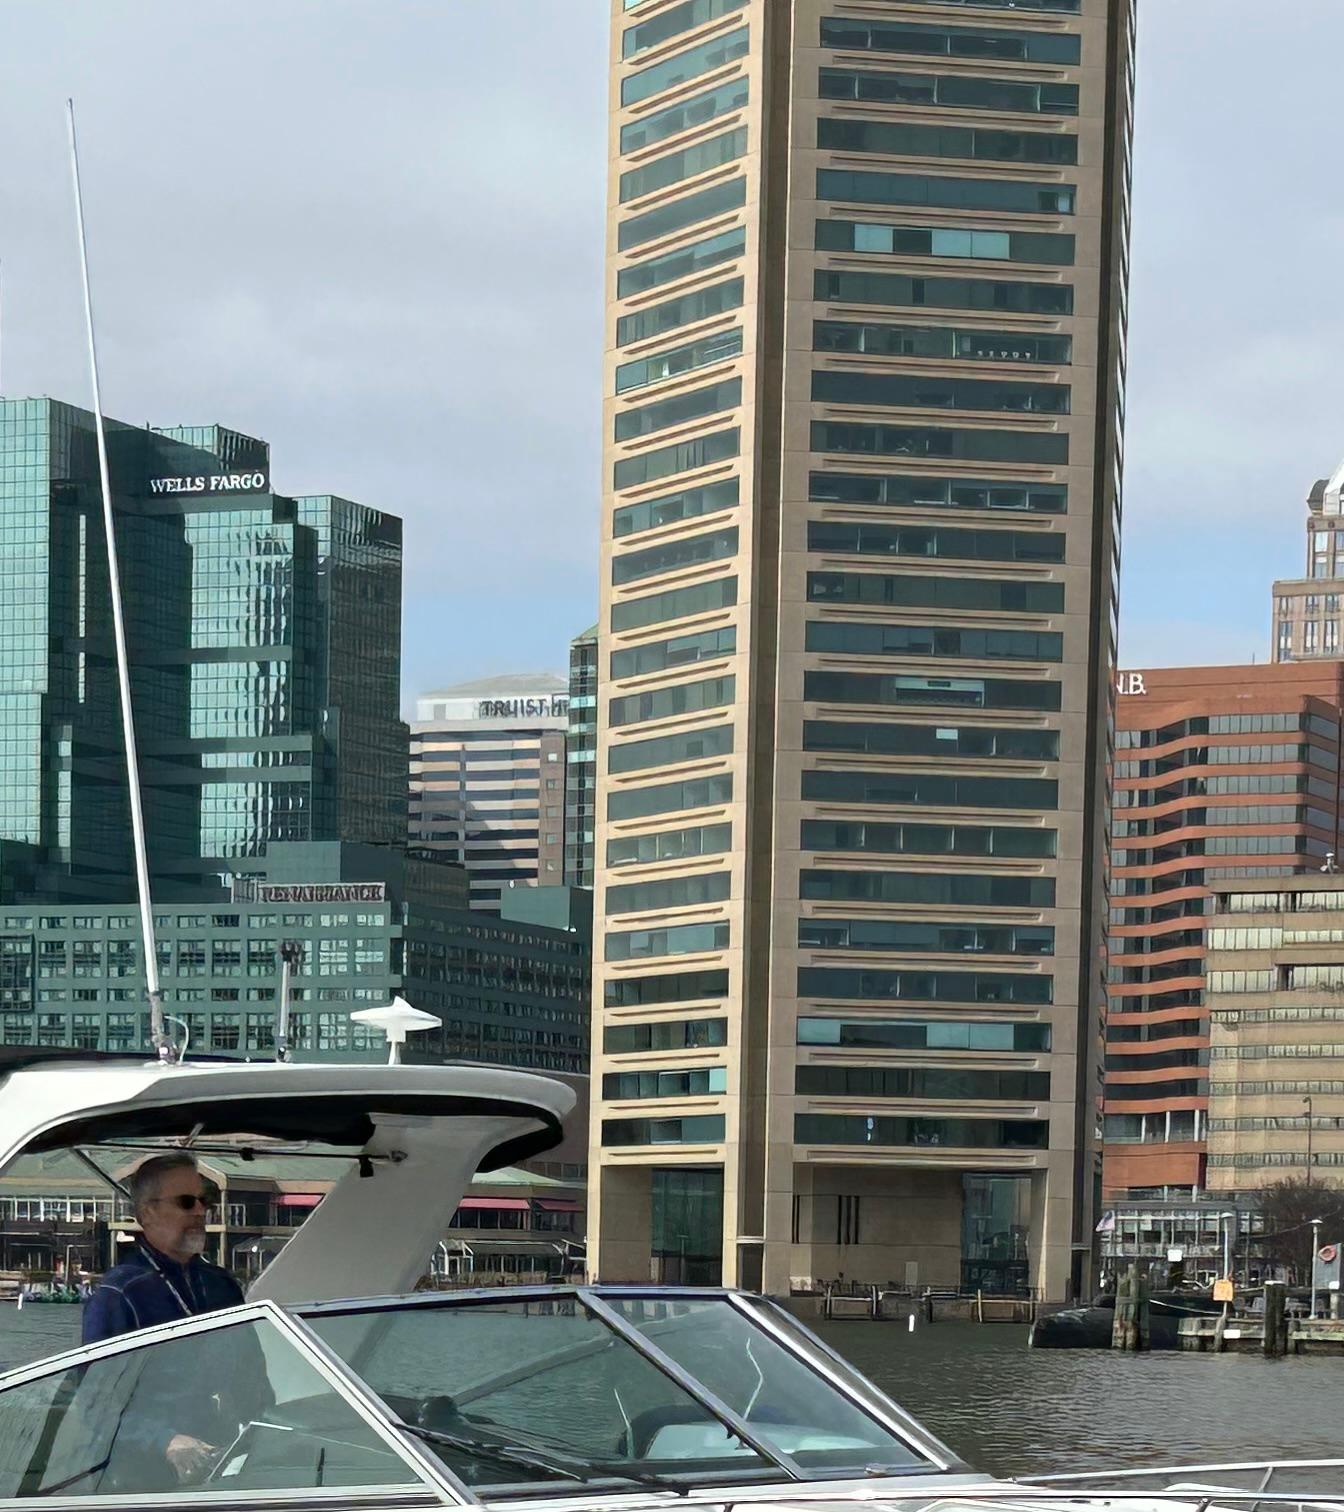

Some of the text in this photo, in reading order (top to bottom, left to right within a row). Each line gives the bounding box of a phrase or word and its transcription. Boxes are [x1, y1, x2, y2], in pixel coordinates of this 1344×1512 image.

[150, 473, 265, 493] WELLS FARGO
[481, 698, 547, 718] TRUIST
